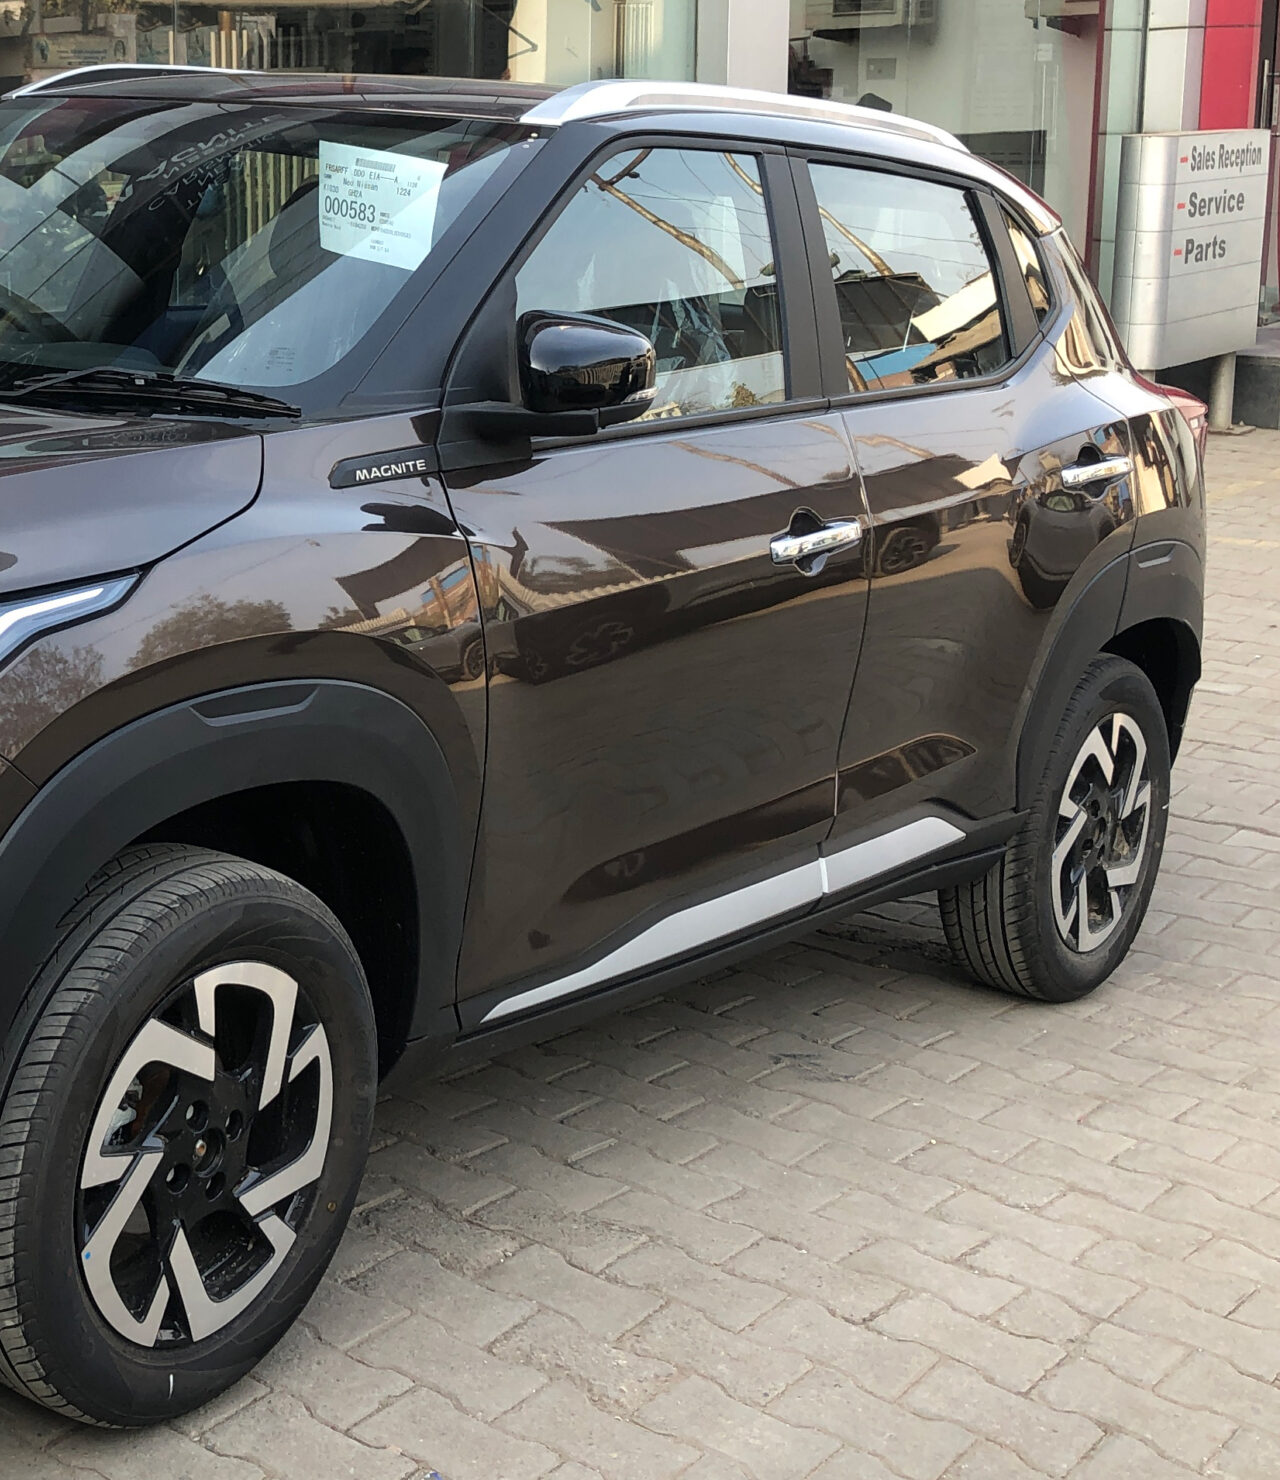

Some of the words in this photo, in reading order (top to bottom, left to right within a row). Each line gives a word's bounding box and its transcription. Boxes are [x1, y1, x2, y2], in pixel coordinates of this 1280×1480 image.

[1190, 145, 1216, 172] Sales
[1218, 141, 1262, 173] Reception
[324, 195, 376, 223] 000583
[1188, 189, 1245, 218] Service
[1184, 235, 1226, 265] Parts
[355, 459, 427, 482] MAGNITE
